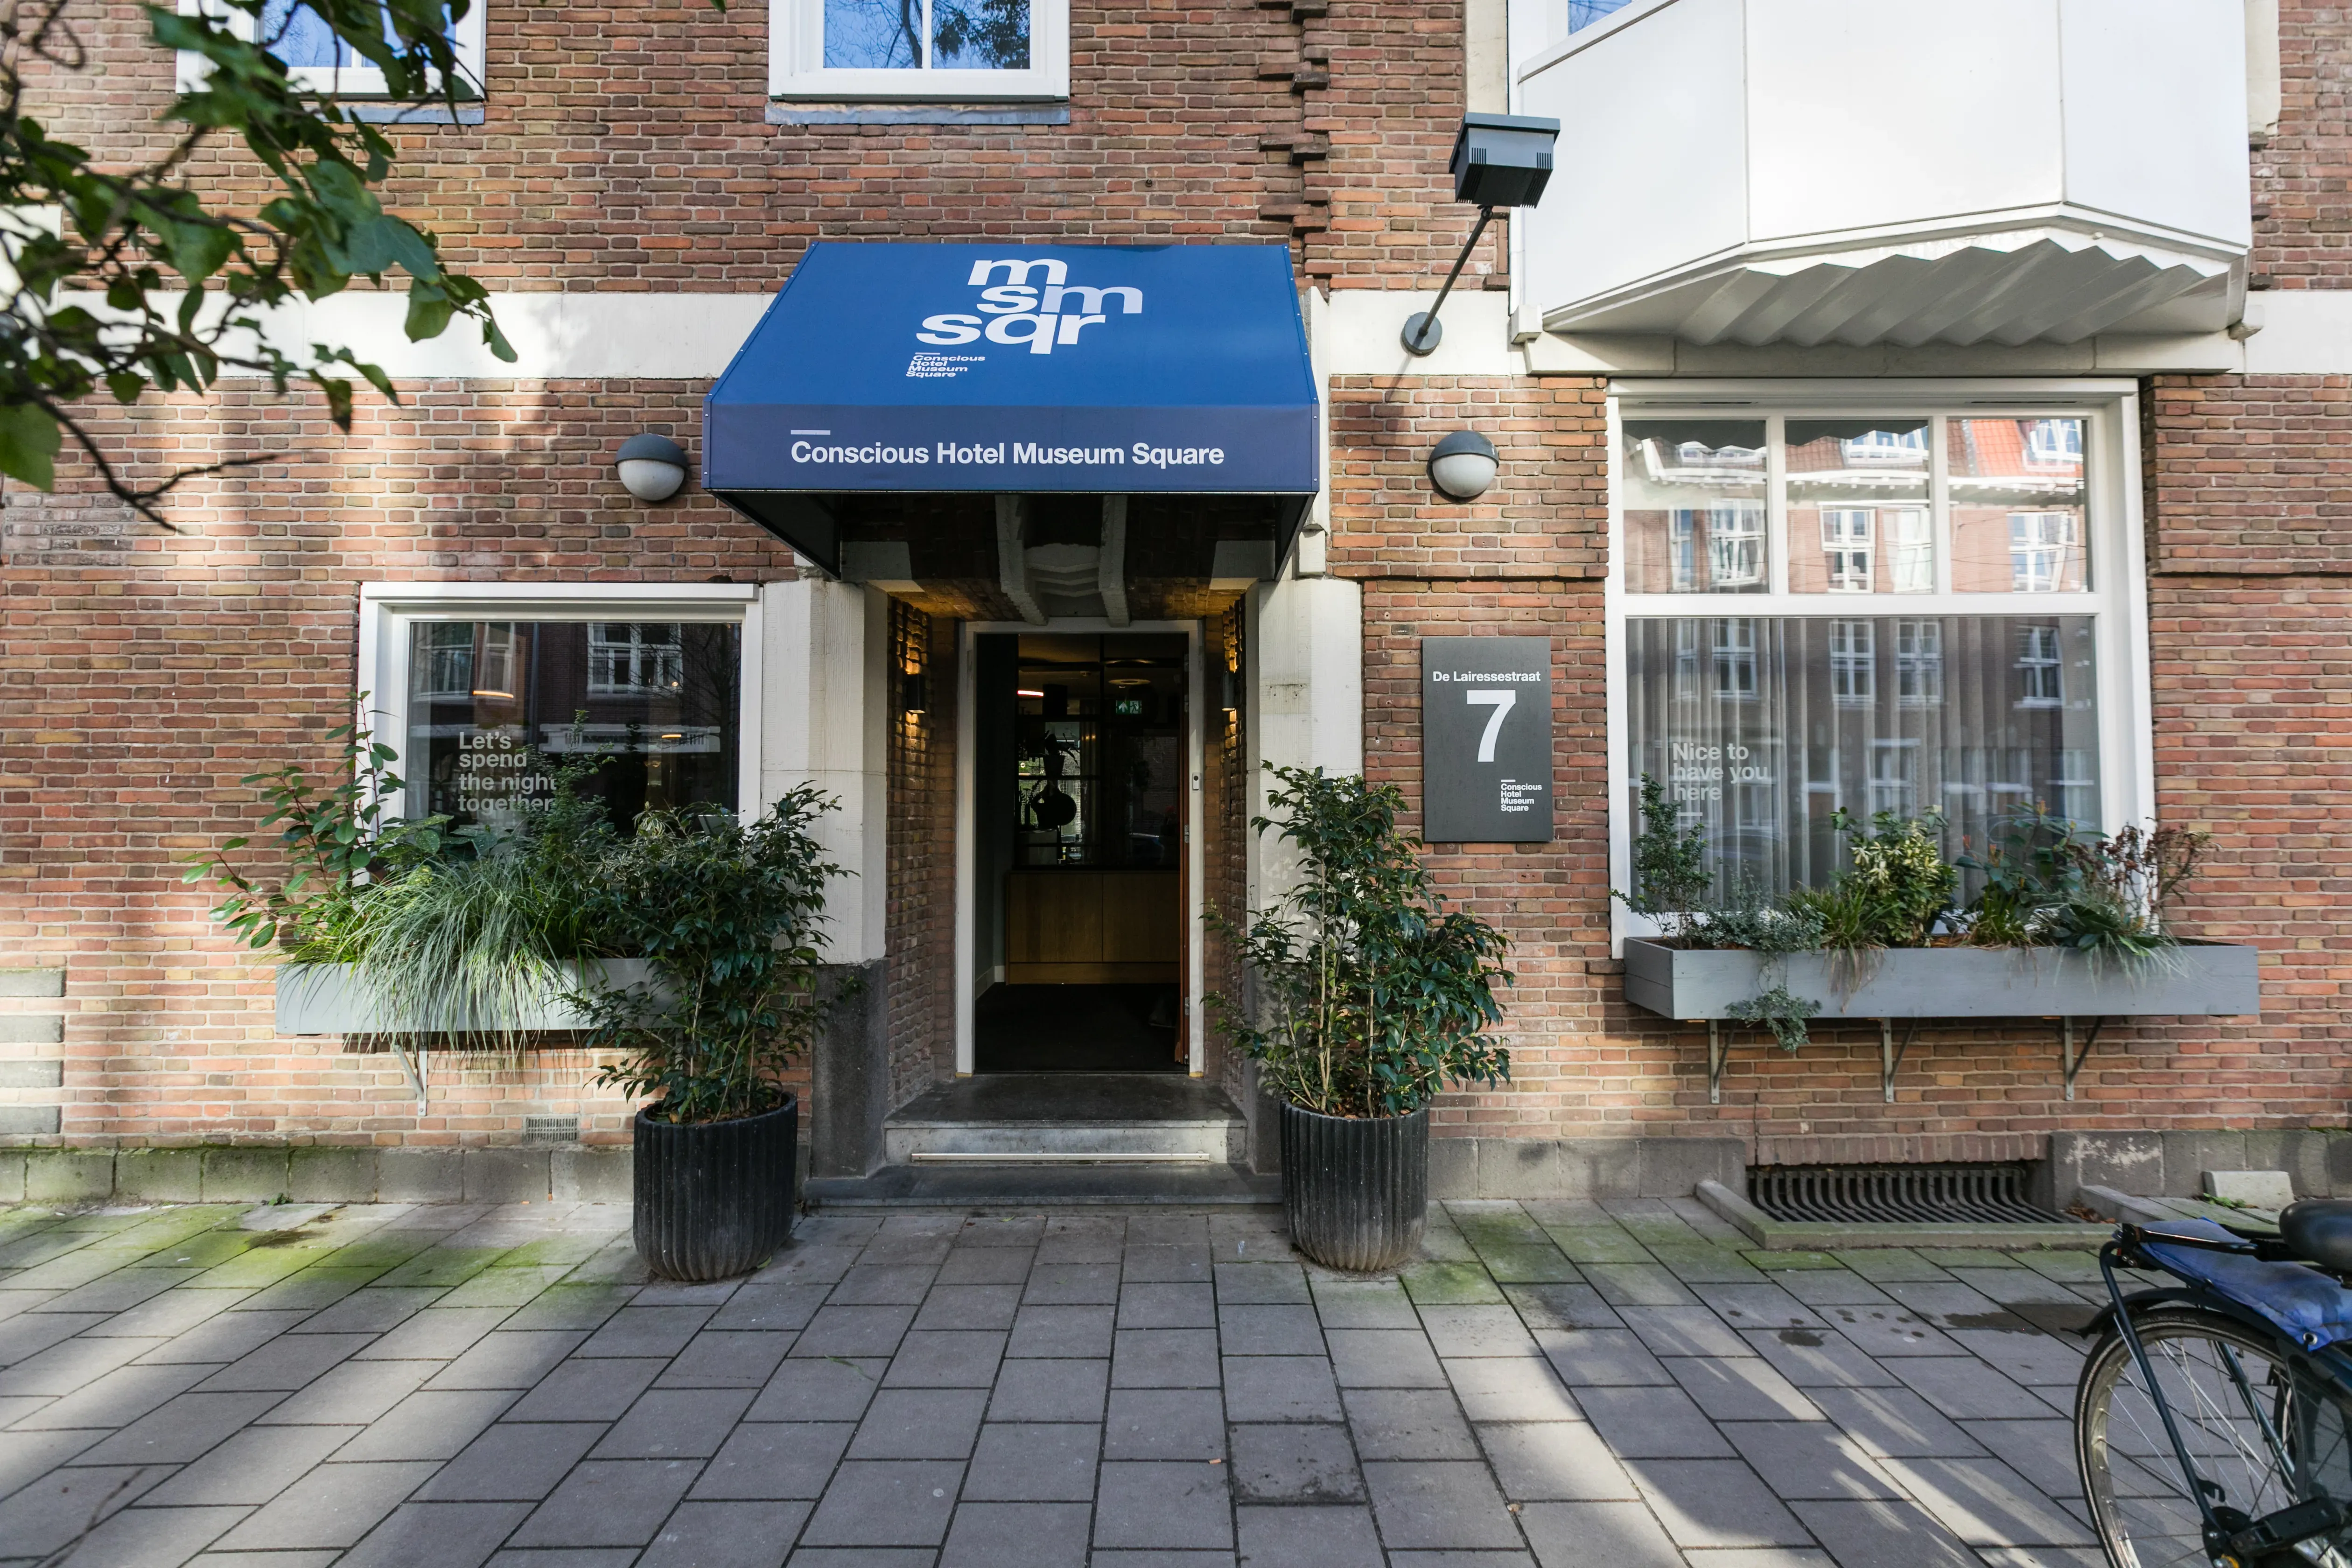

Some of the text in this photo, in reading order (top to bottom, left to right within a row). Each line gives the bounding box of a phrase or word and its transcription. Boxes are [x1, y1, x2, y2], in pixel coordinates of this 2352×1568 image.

[916, 313, 1106, 354] sqr
[791, 441, 1225, 469] Conscious Hotel Museum Square
[1433, 671, 1541, 682] De Lairessestraat
[1467, 690, 1516, 762] 7
[459, 731, 511, 749] Let's
[459, 752, 527, 771] spend
[1673, 743, 1749, 760] Nice to
[458, 773, 557, 794] the night
[1673, 763, 1768, 784] have you
[1674, 783, 1722, 800] here
[458, 794, 553, 816] together
[1501, 804, 1529, 812] Square
